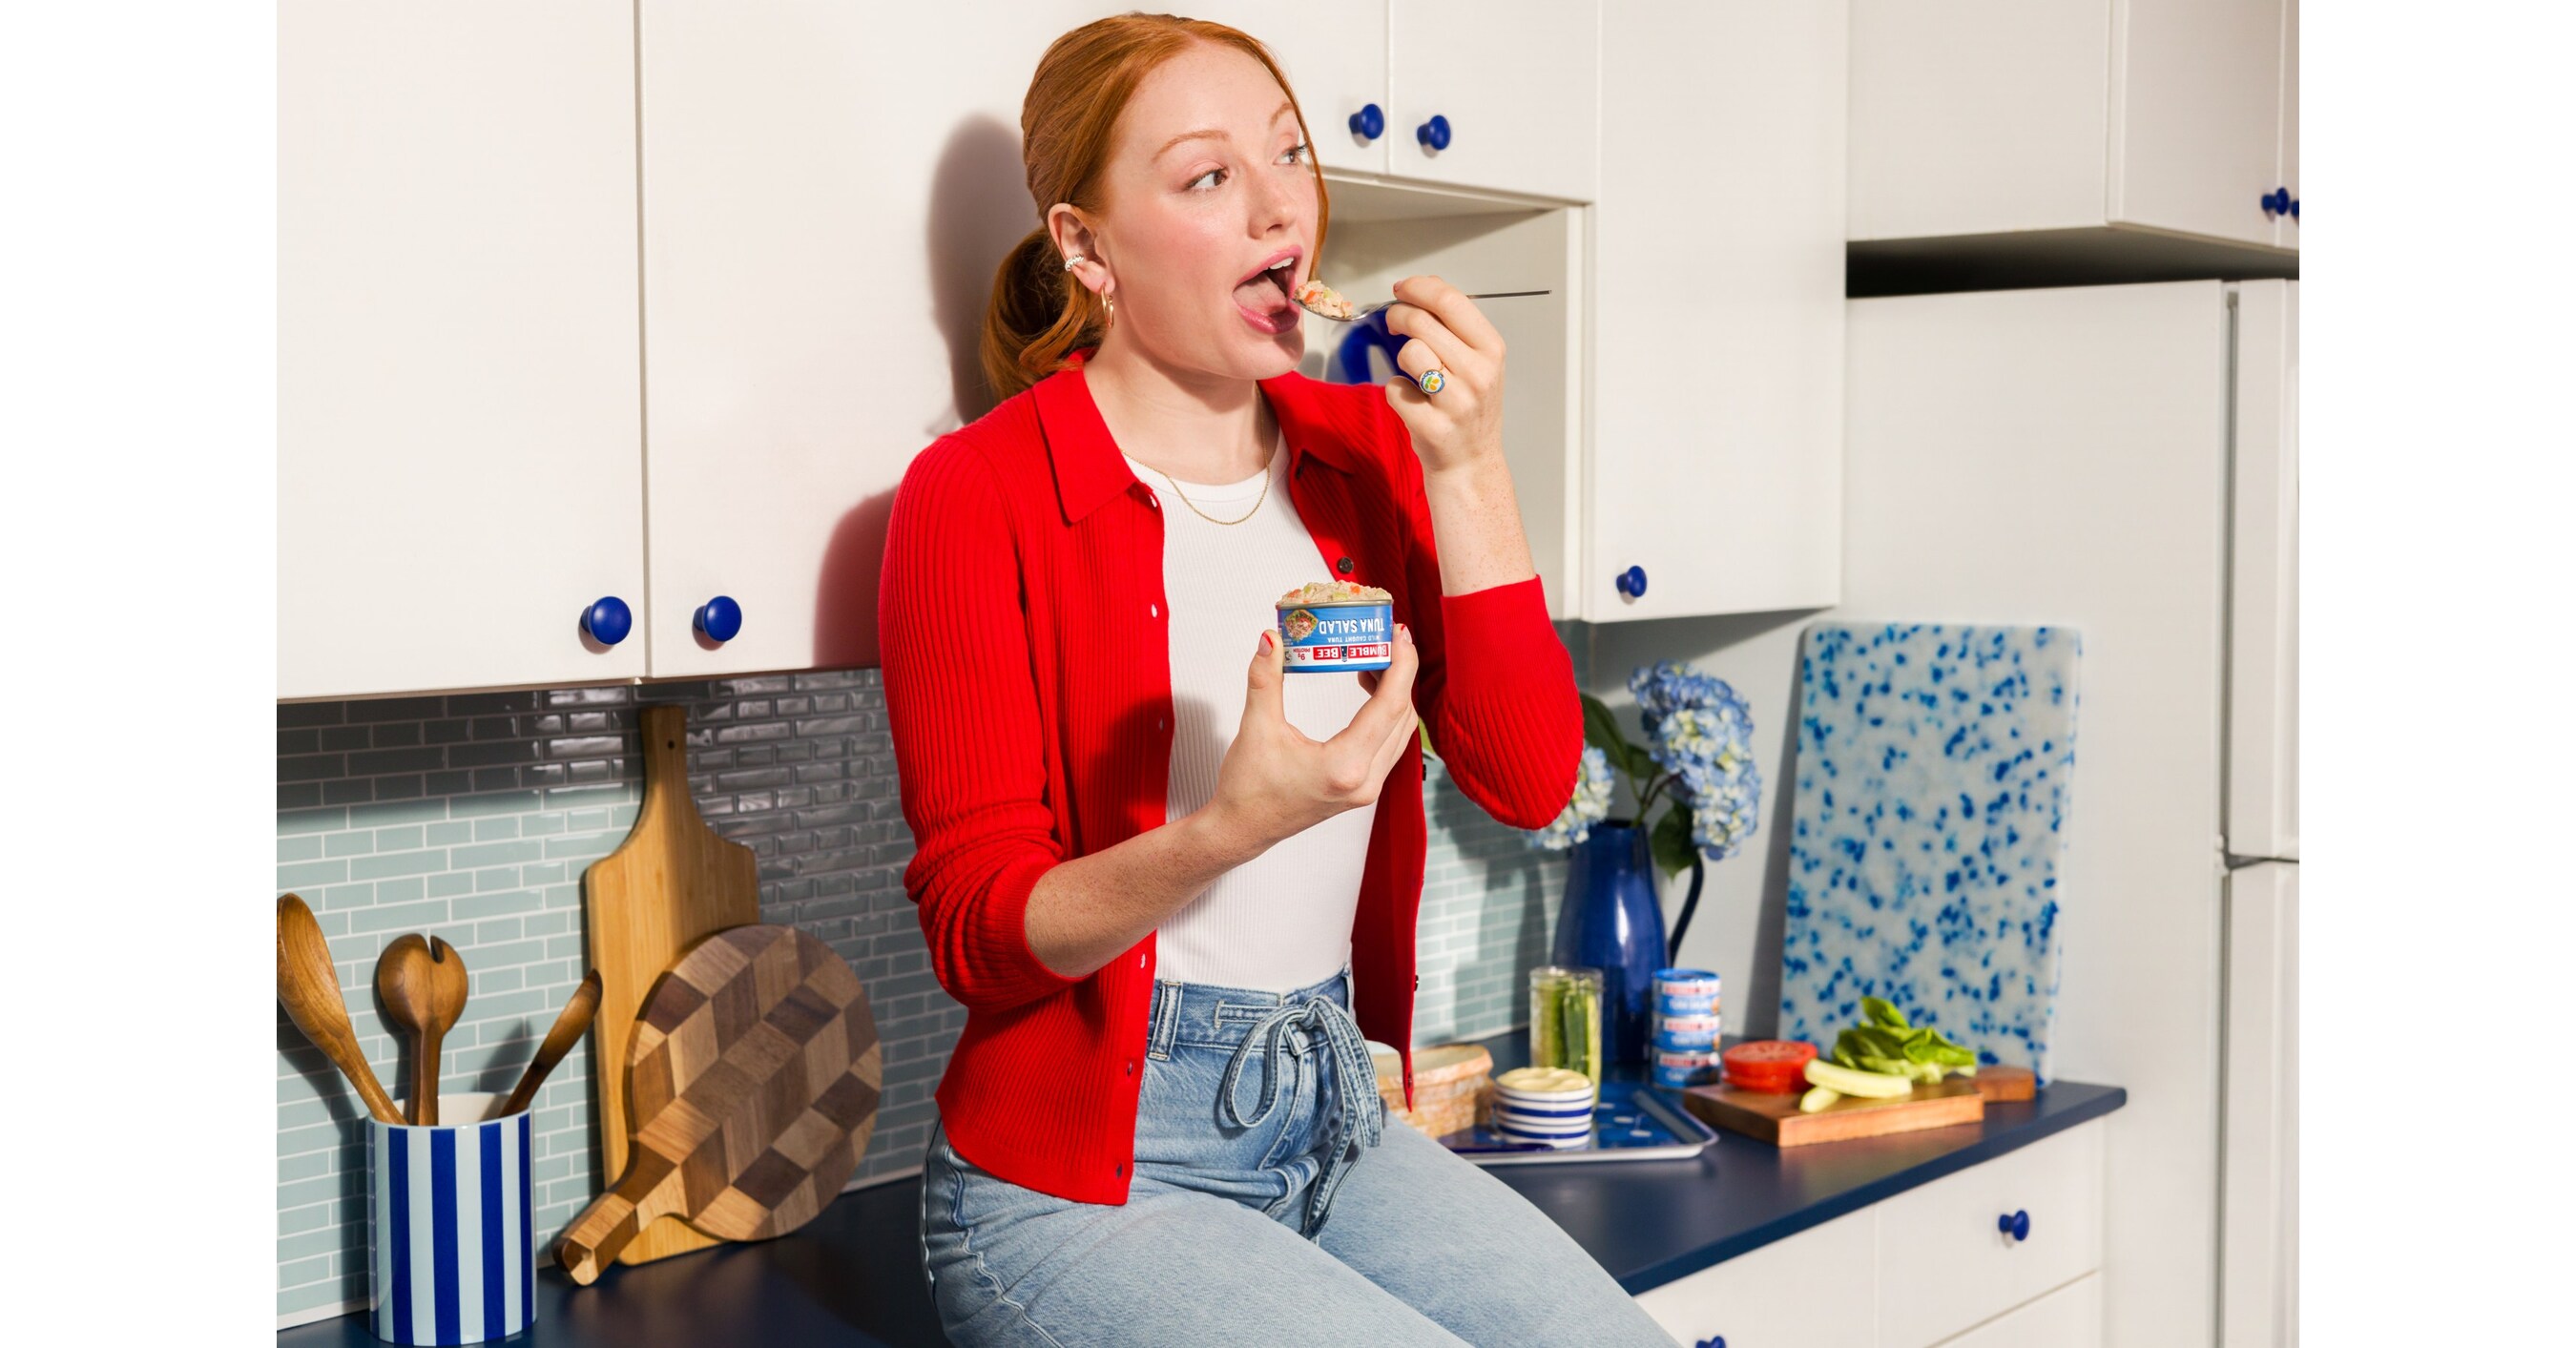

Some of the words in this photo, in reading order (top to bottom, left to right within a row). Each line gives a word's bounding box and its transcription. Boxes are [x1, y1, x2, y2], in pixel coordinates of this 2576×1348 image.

[1319, 620, 1357, 634] SALAD
[1360, 618, 1384, 633] TUNA
[1318, 648, 1339, 657] BEE
[1350, 645, 1387, 656] BUMBLE
